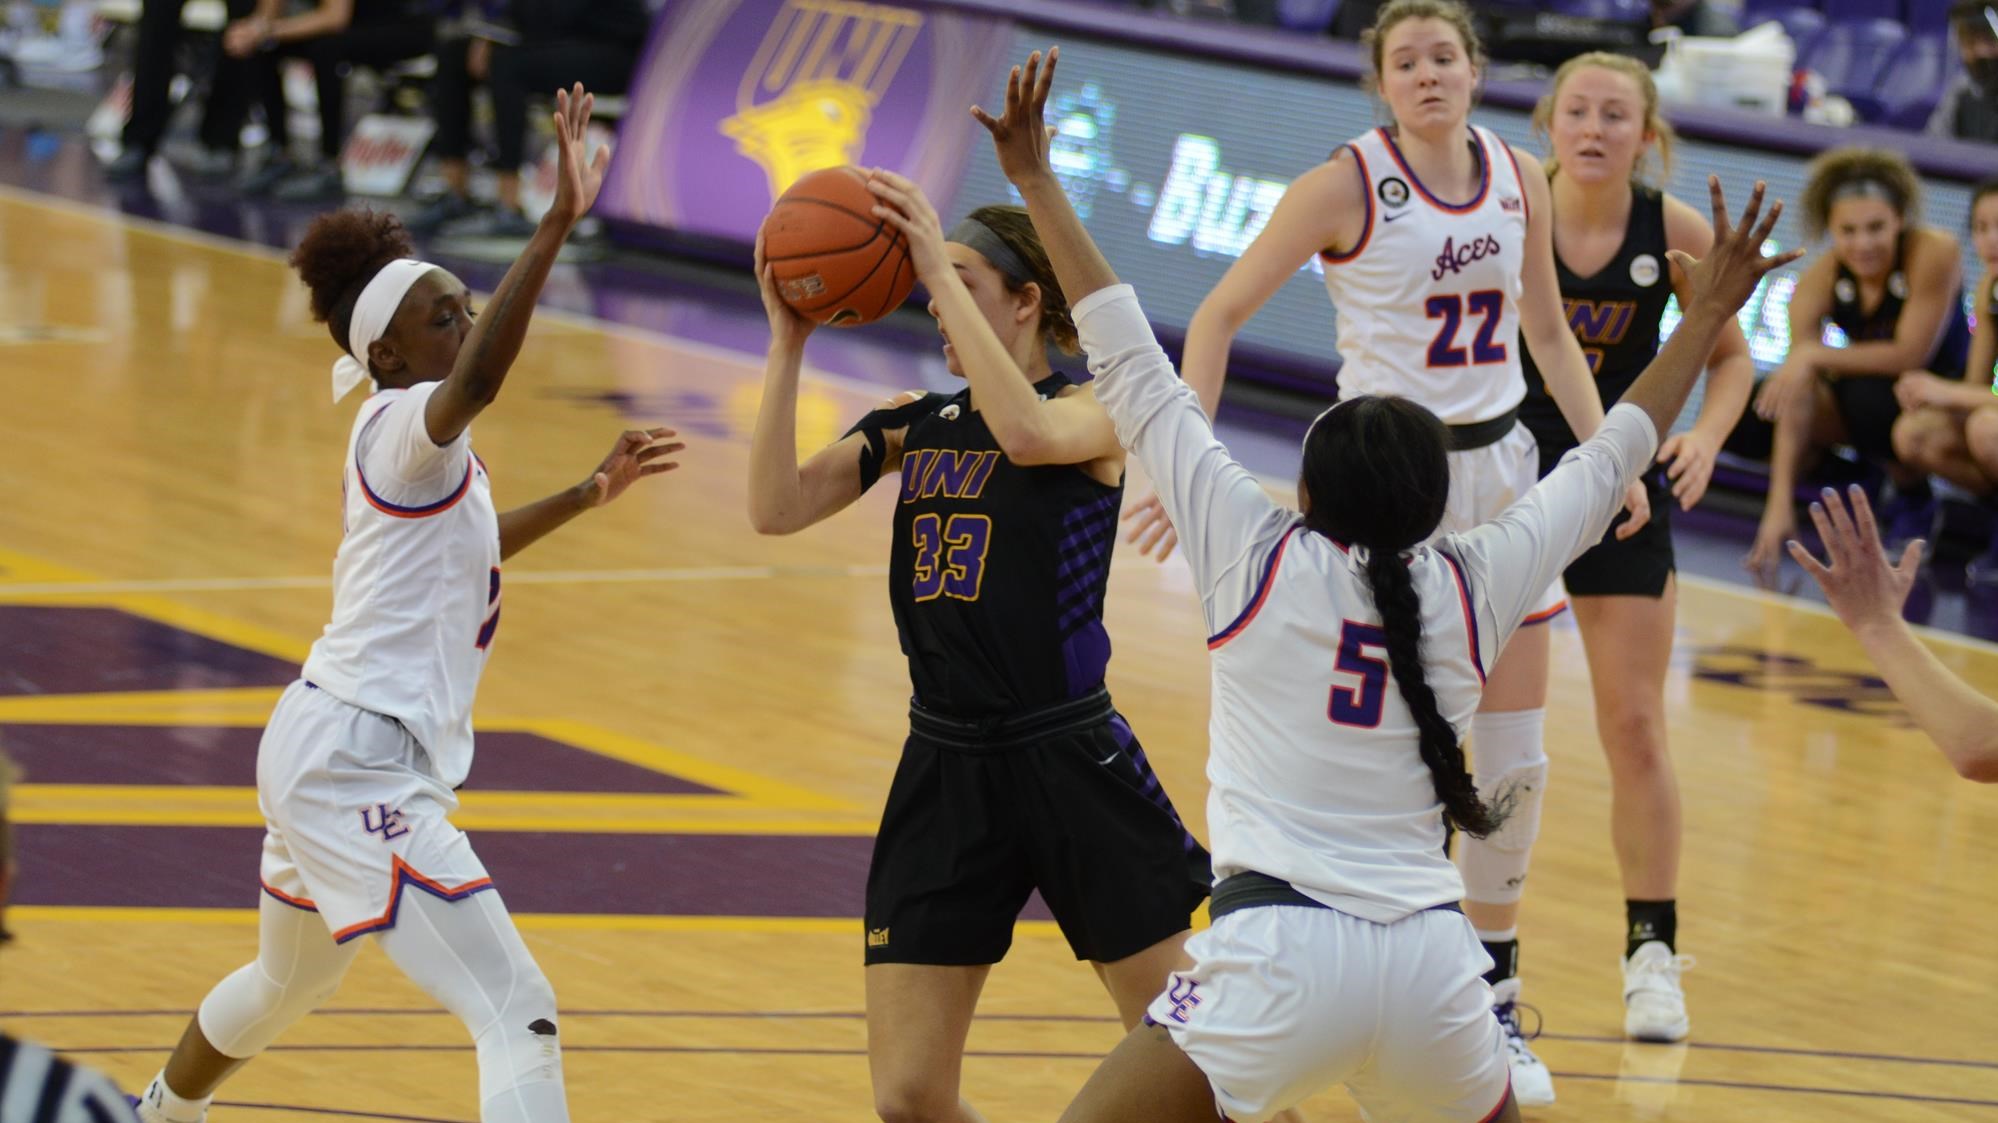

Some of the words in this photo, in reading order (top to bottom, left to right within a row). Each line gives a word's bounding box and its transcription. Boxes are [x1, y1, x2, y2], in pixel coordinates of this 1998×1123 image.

[736, 0, 923, 118] UNI
[1425, 289, 1507, 368] 22
[1561, 297, 1637, 344] NI
[901, 448, 1001, 504] UNI
[912, 512, 993, 602] 33
[1326, 617, 1389, 730] 5
